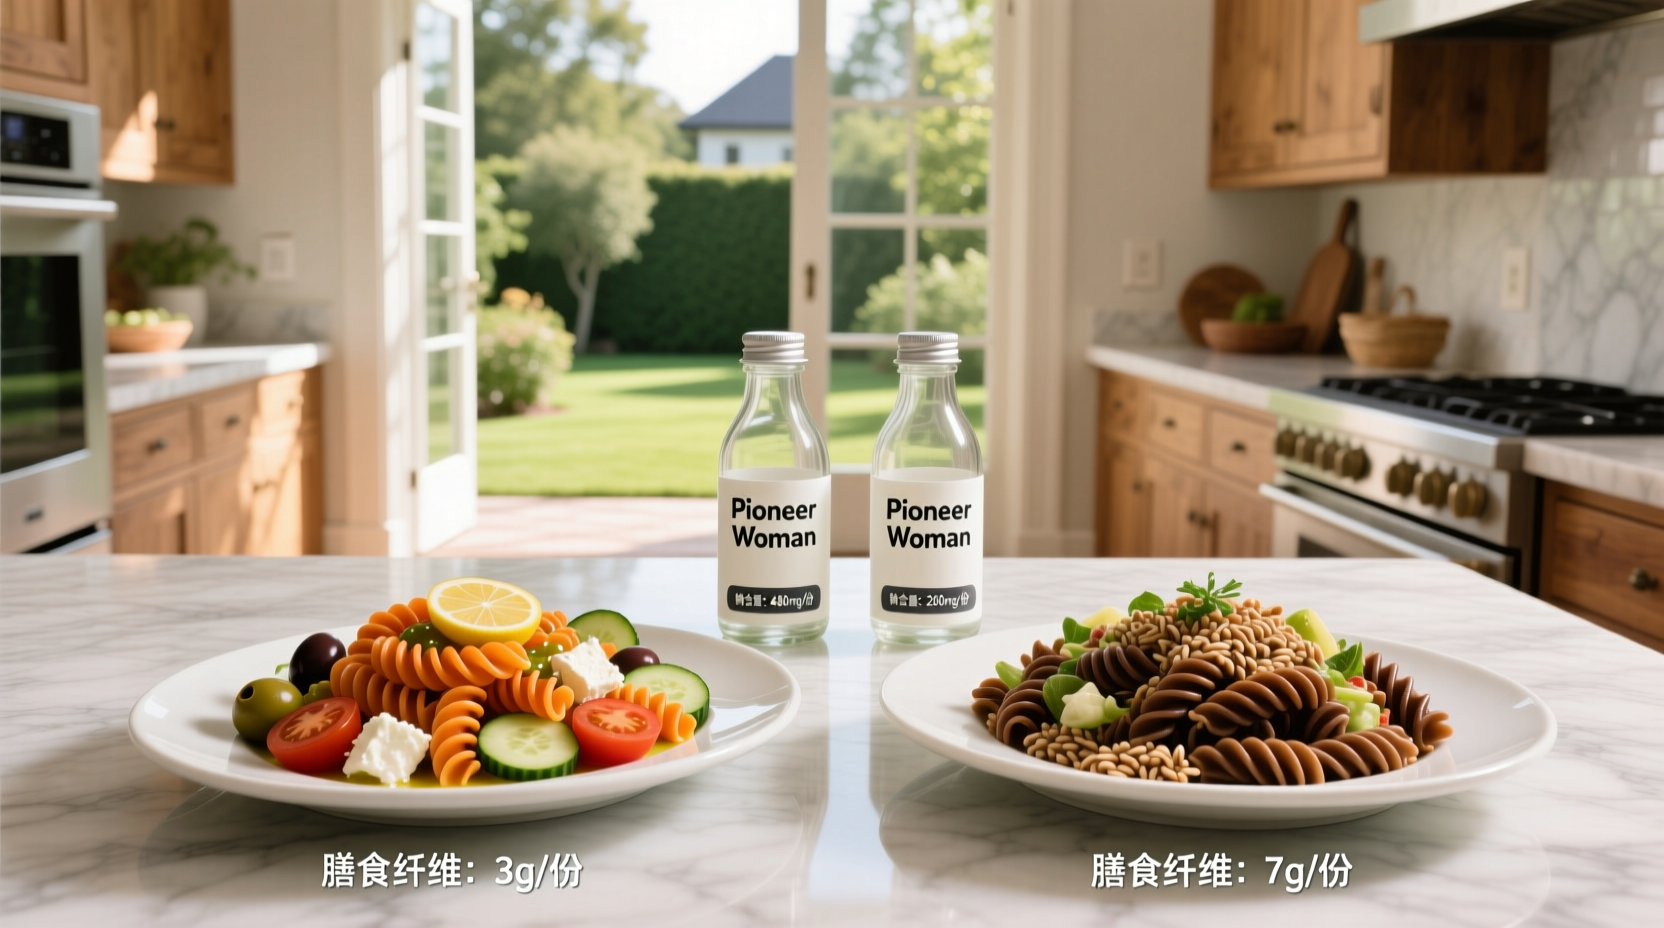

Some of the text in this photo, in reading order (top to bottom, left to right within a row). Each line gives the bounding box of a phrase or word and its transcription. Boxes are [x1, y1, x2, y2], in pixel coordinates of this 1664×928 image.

[731, 497, 817, 521] Pioneer
[886, 497, 972, 521] Pioneer
[731, 525, 816, 549] Woman
[886, 525, 971, 549] Woman
